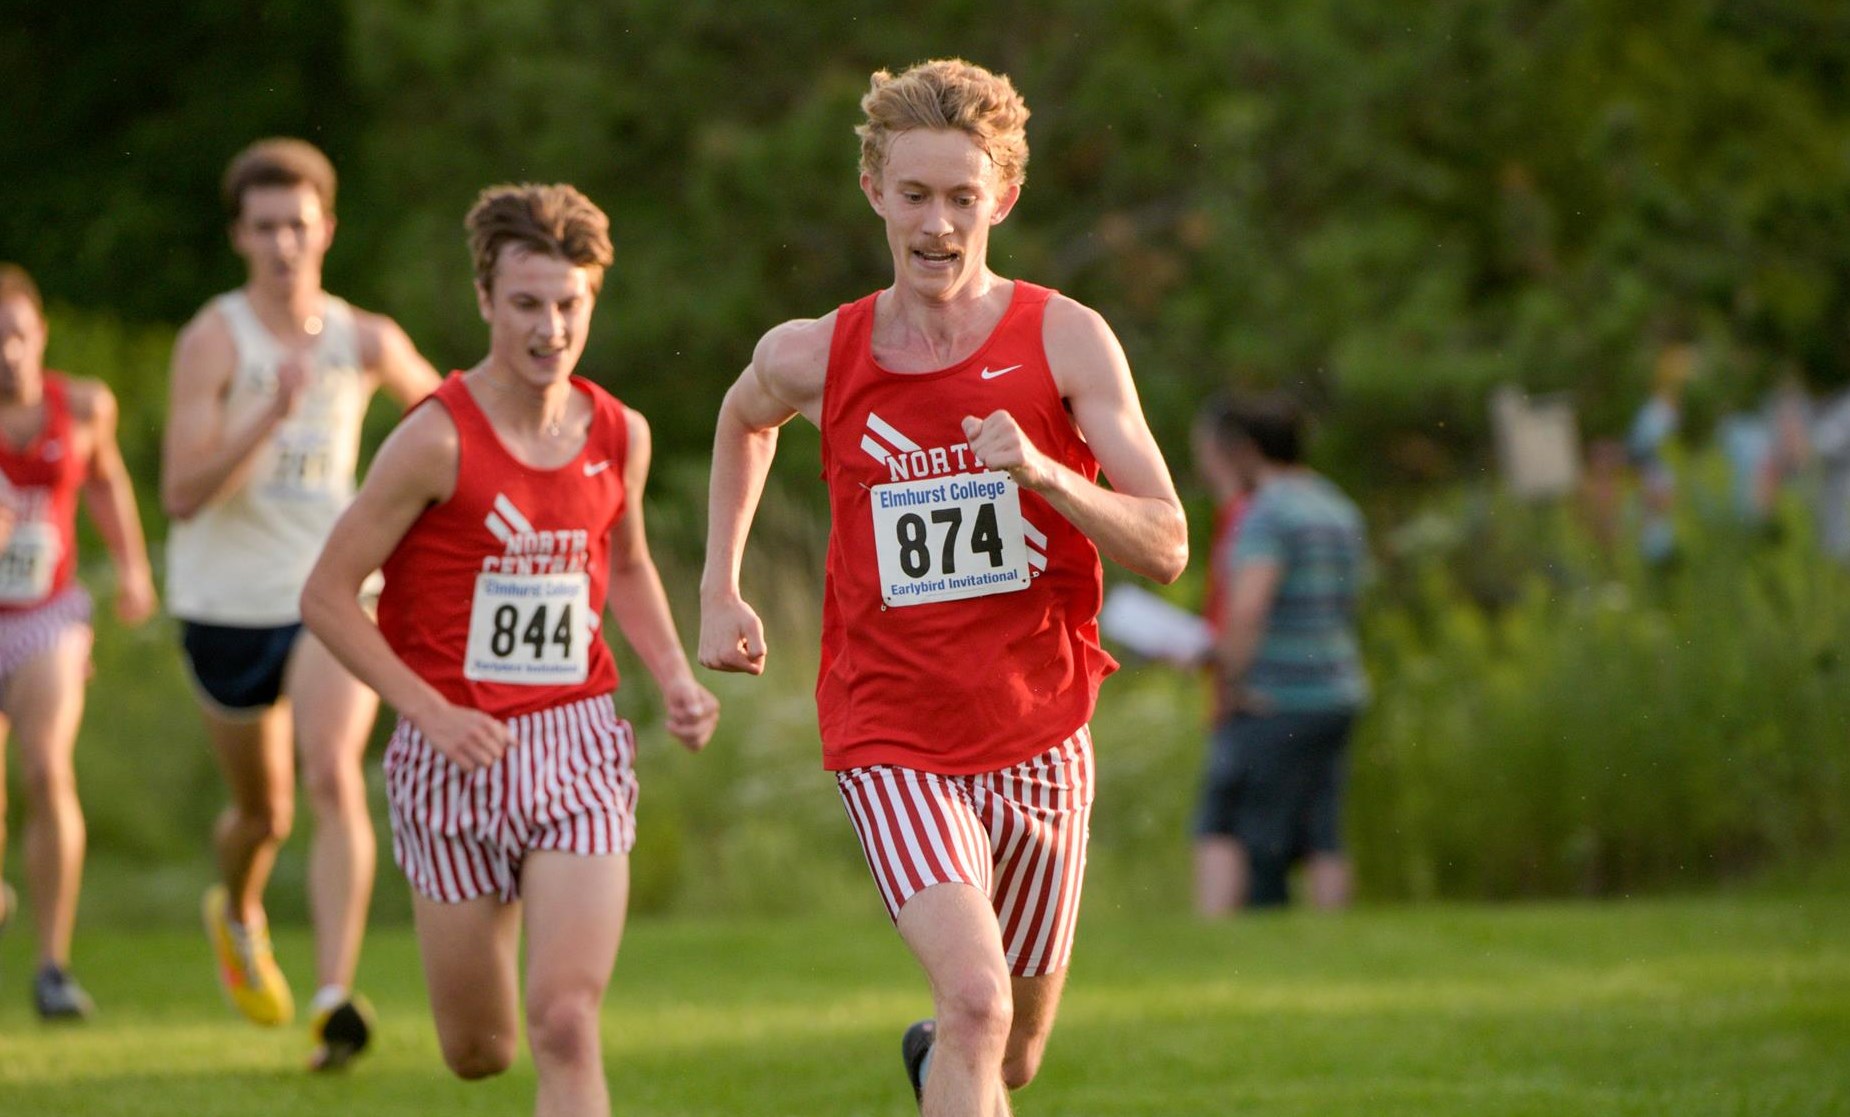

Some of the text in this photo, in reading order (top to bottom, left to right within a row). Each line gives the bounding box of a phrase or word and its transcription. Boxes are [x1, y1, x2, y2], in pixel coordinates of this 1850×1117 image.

[886, 443, 984, 482] NORT
[880, 481, 1005, 508] Elmhurst College
[506, 529, 588, 555] NORTH
[896, 503, 1004, 579] 874
[891, 569, 1018, 596] Earlybird Invitational
[491, 603, 572, 659] 844
